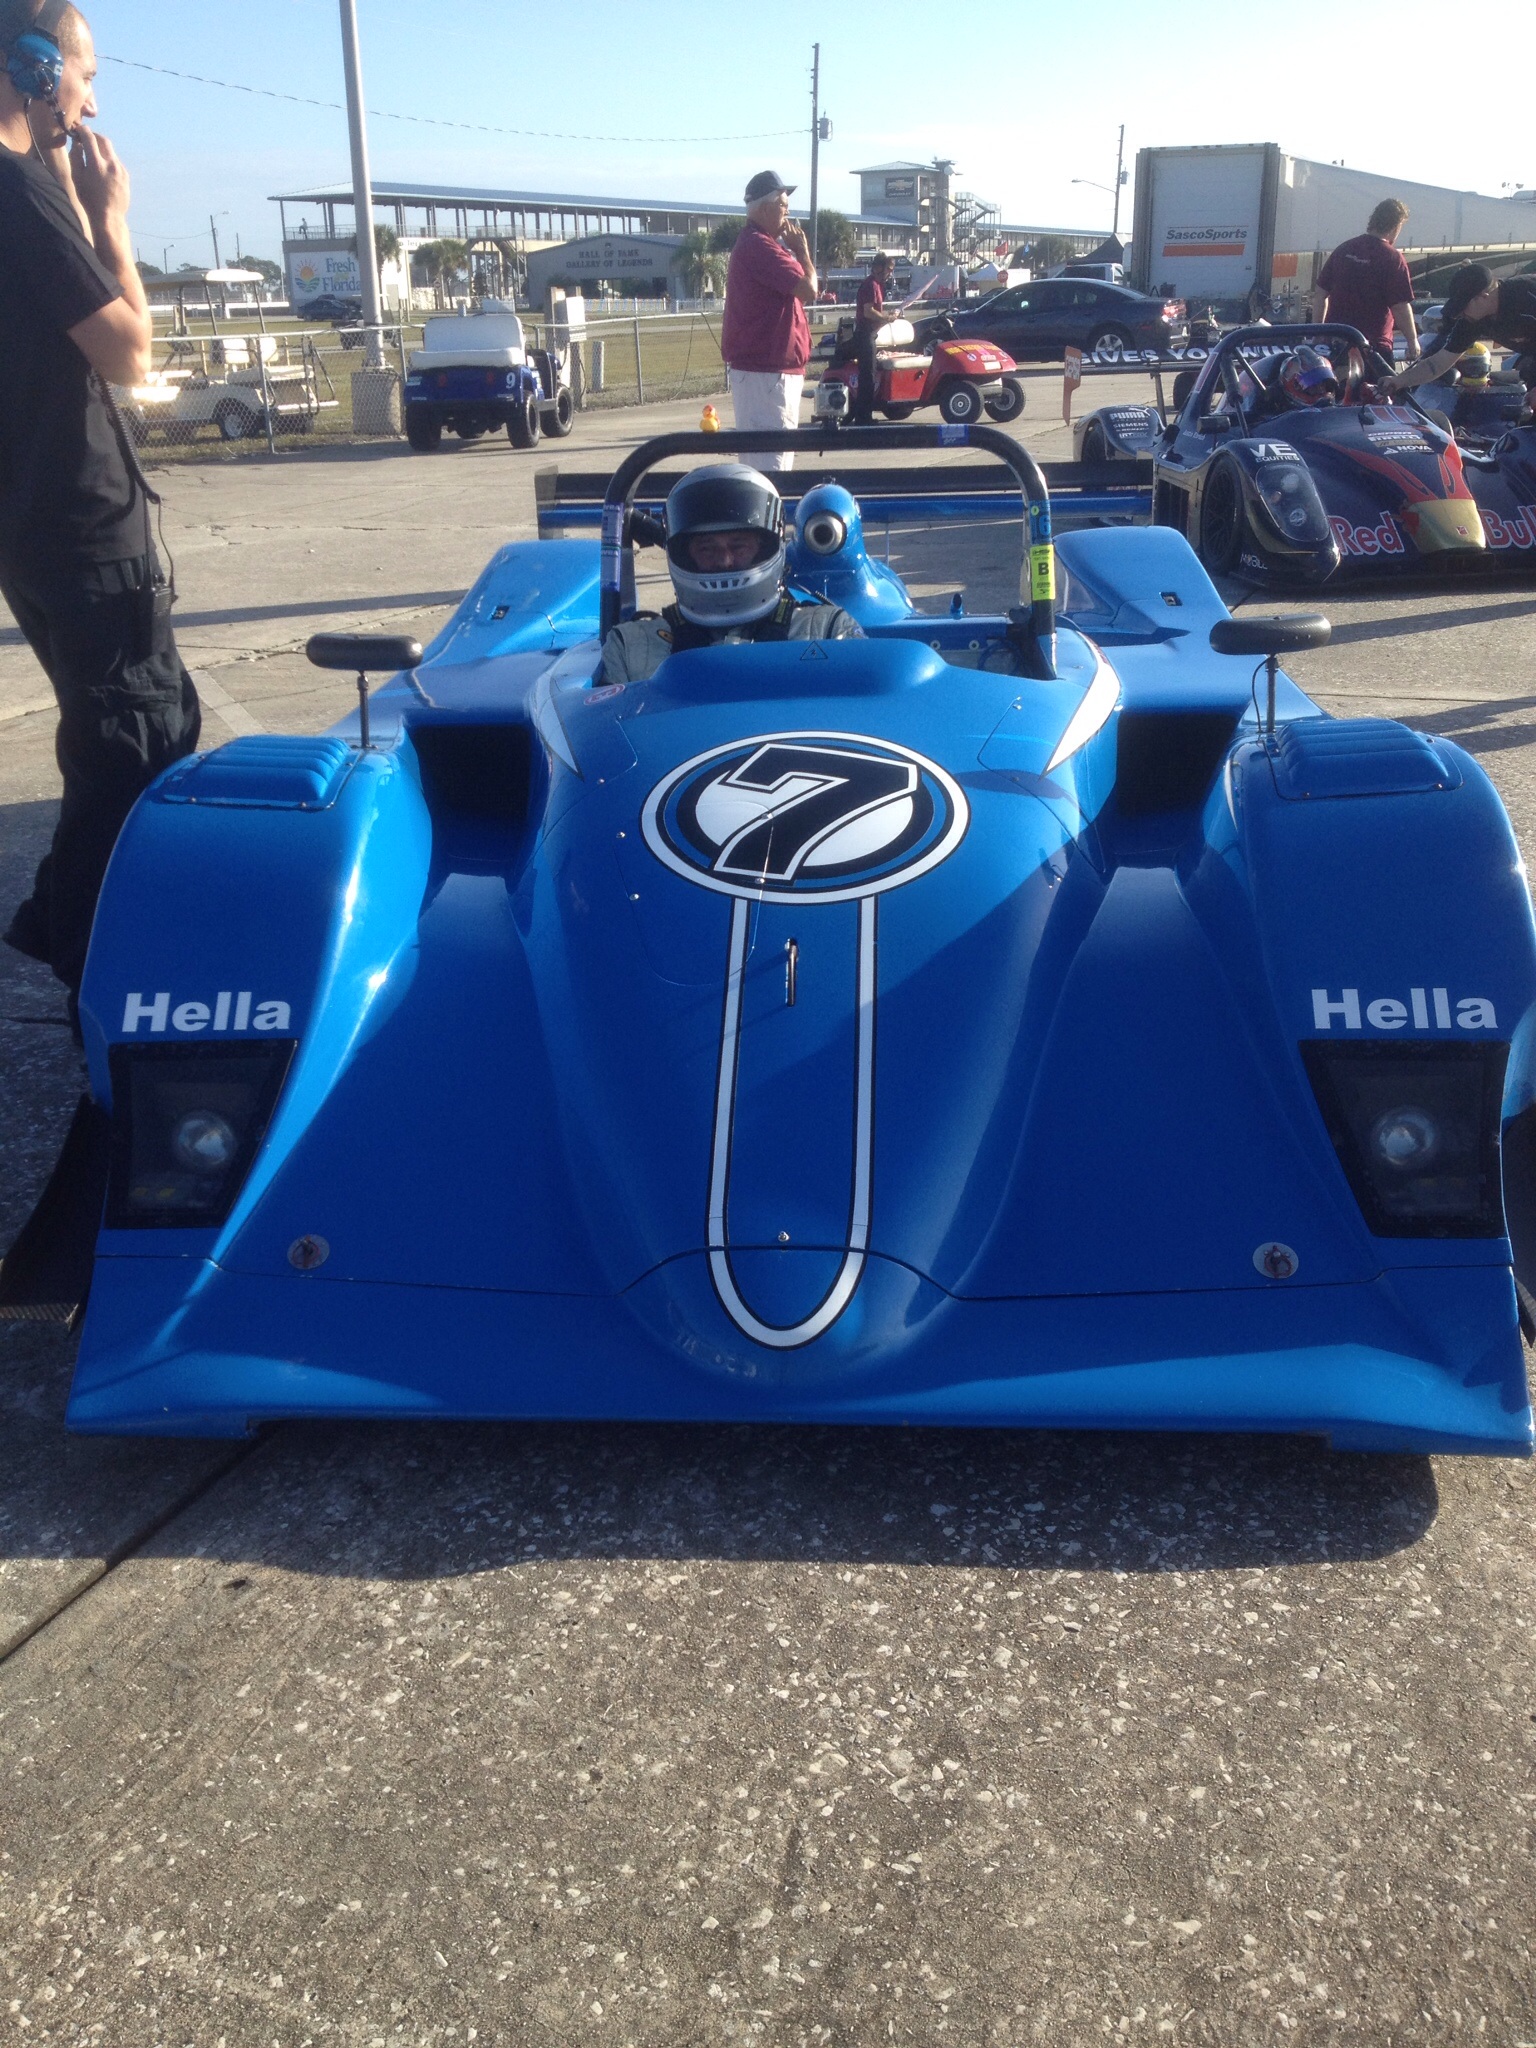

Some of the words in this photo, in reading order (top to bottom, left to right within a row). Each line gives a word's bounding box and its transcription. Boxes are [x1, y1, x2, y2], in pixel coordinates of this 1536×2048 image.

[1166, 229, 1247, 240] SascoSports
[325, 257, 356, 273] Fresh
[322, 276, 361, 292] Florida
[506, 372, 516, 389] 9
[1328, 510, 1405, 556] Red
[1038, 563, 1049, 576] B
[713, 743, 919, 883] 7
[122, 991, 291, 1032] Hella
[1311, 987, 1498, 1030] Hella
